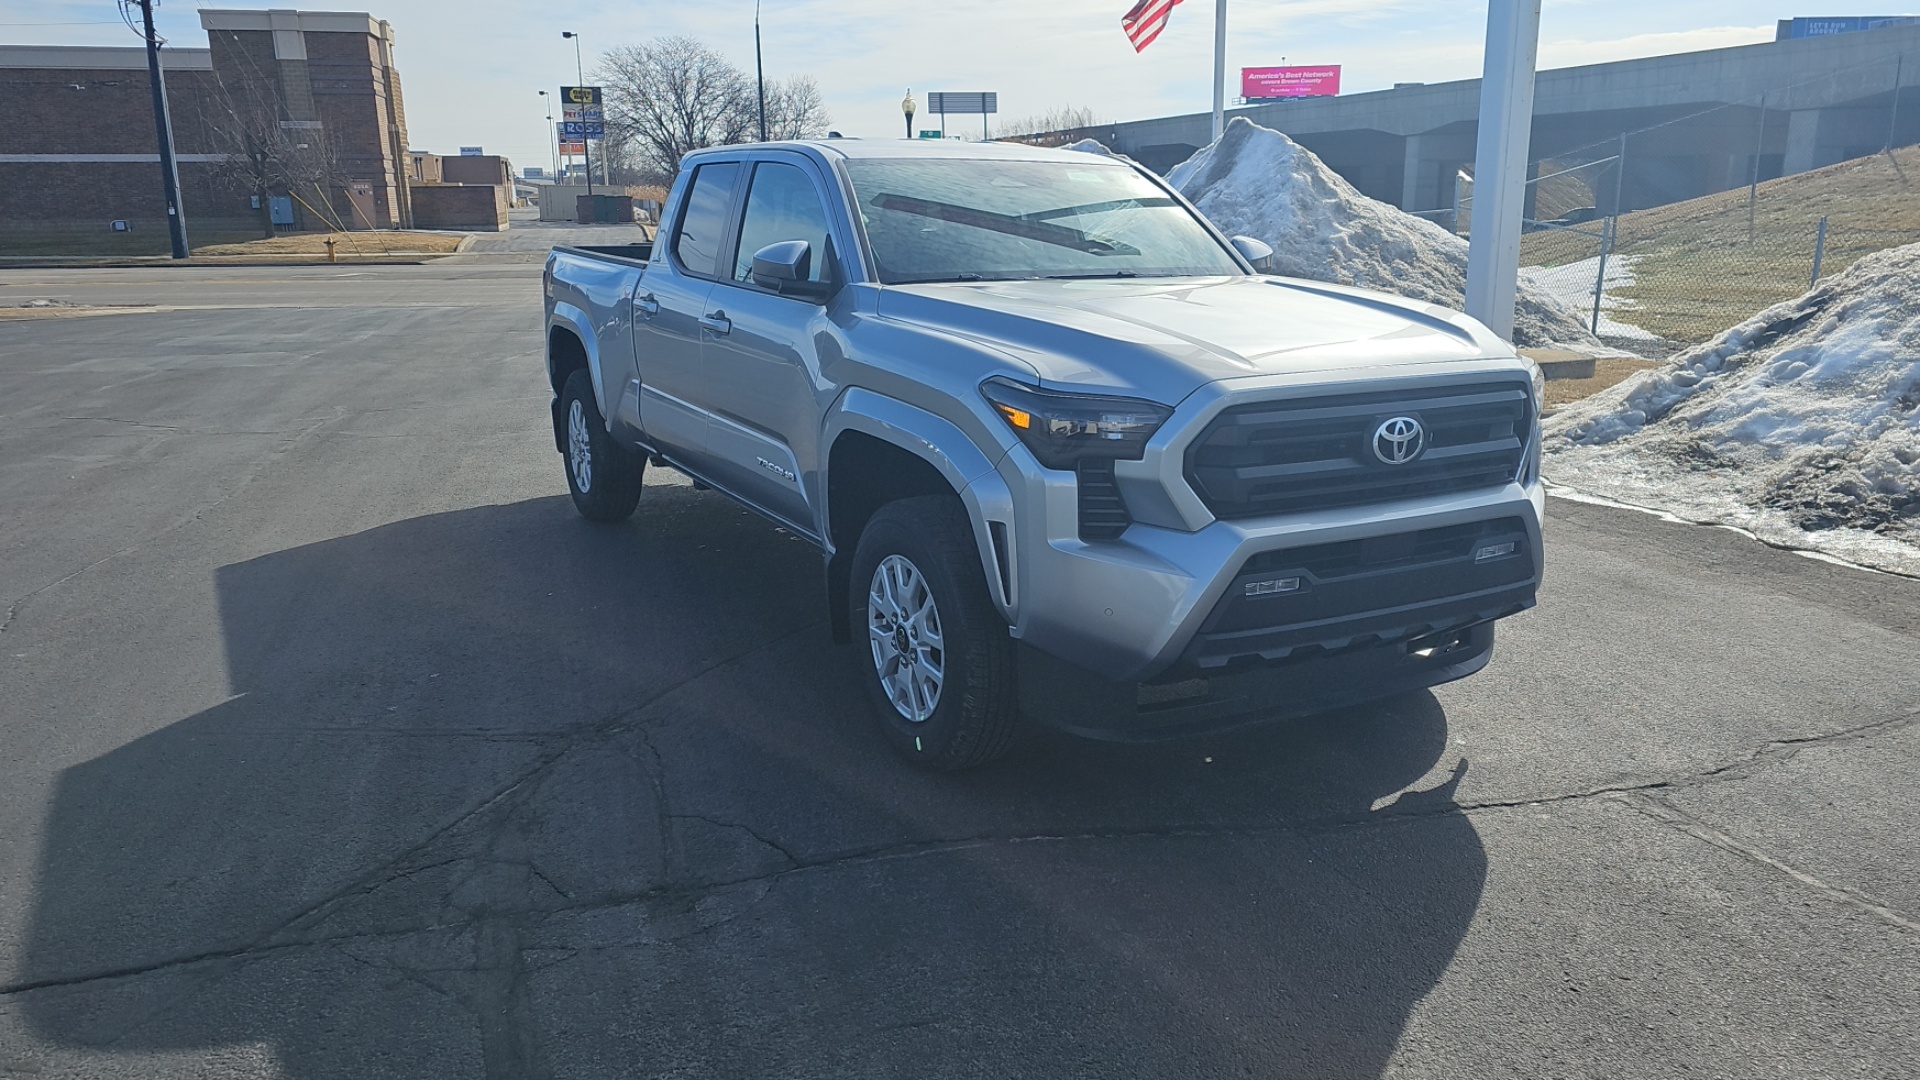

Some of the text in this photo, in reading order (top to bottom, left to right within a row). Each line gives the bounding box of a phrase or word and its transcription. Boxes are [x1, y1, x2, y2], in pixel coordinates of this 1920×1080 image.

[1248, 72, 1284, 80] America's
[1303, 71, 1334, 79] Network
[567, 123, 602, 132] ROSS
[756, 456, 796, 481] TACOMA
